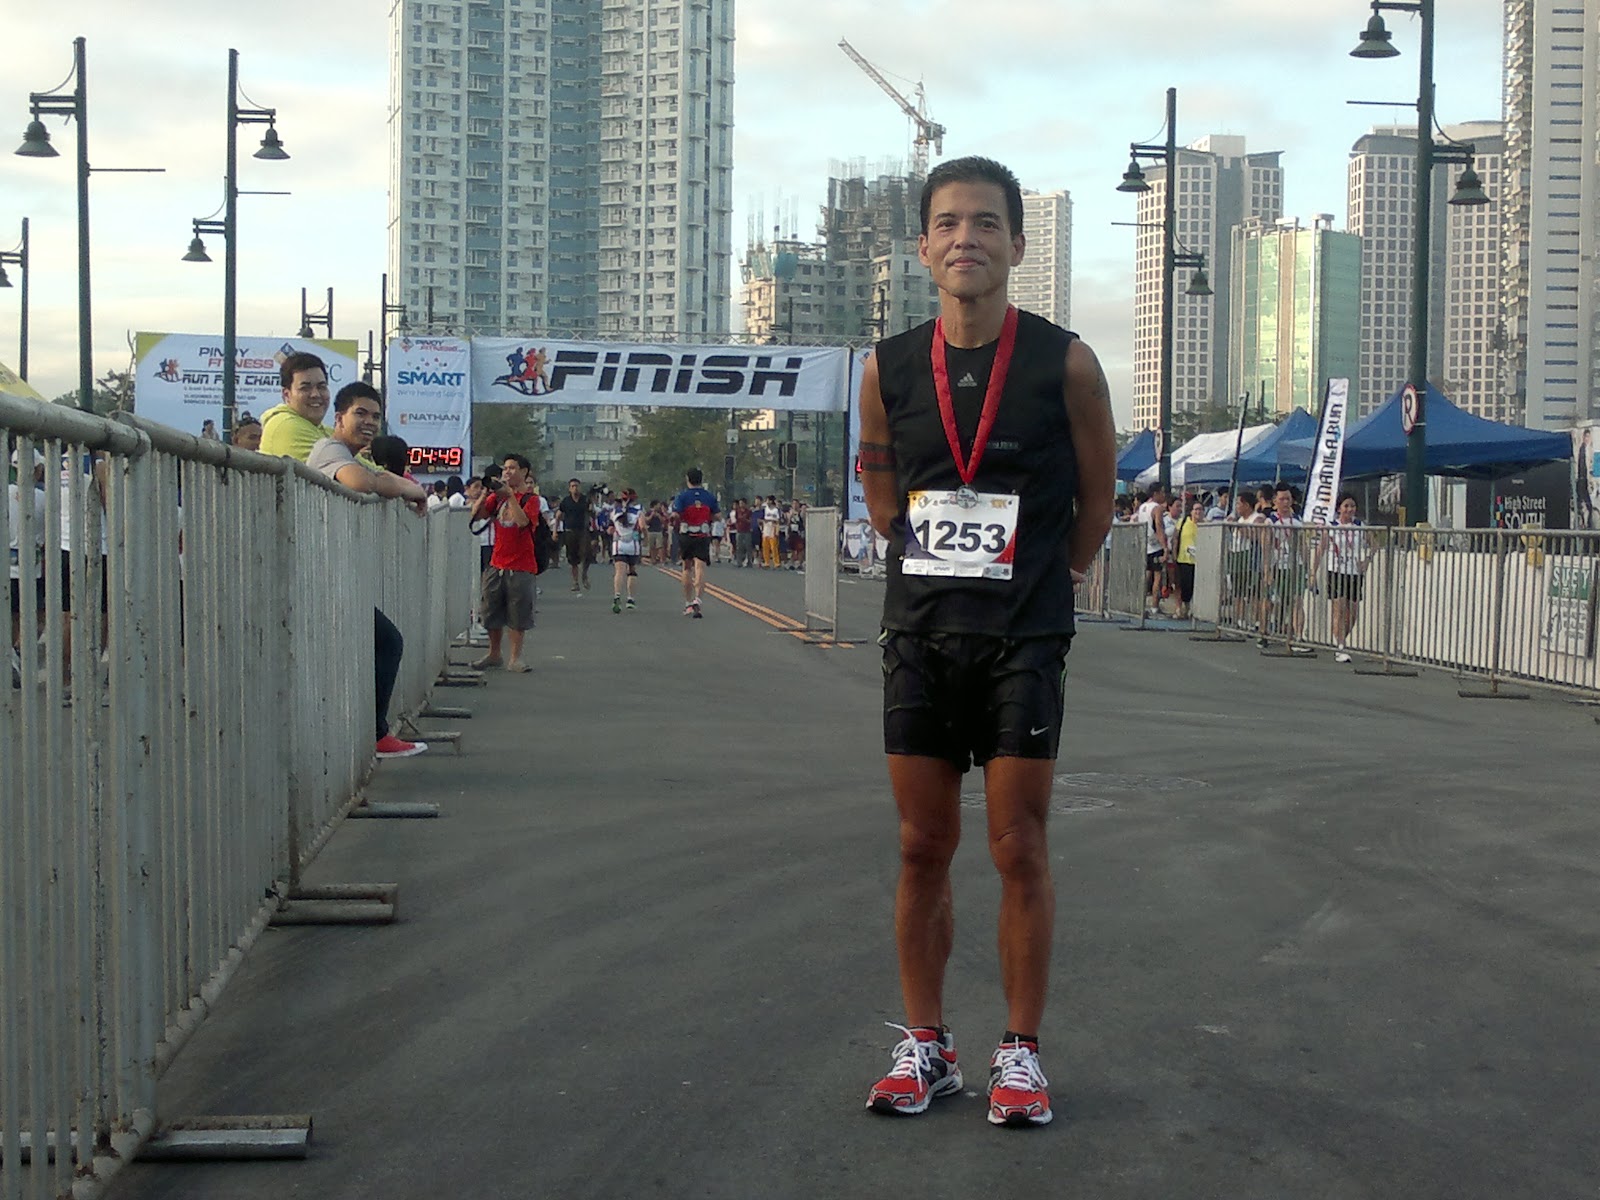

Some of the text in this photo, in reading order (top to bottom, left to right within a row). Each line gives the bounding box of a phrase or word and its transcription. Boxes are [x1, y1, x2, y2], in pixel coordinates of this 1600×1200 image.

[208, 358, 274, 369] FINESS
[183, 374, 209, 385] RUN
[214, 374, 240, 386] FR
[398, 371, 466, 386] SMART
[550, 350, 803, 397] FINISH
[408, 413, 461, 421] NATHAN
[1326, 403, 1344, 435] RUN
[1316, 438, 1339, 503] MANILA
[1504, 495, 1546, 514] High Street
[915, 519, 1006, 554] 1253
